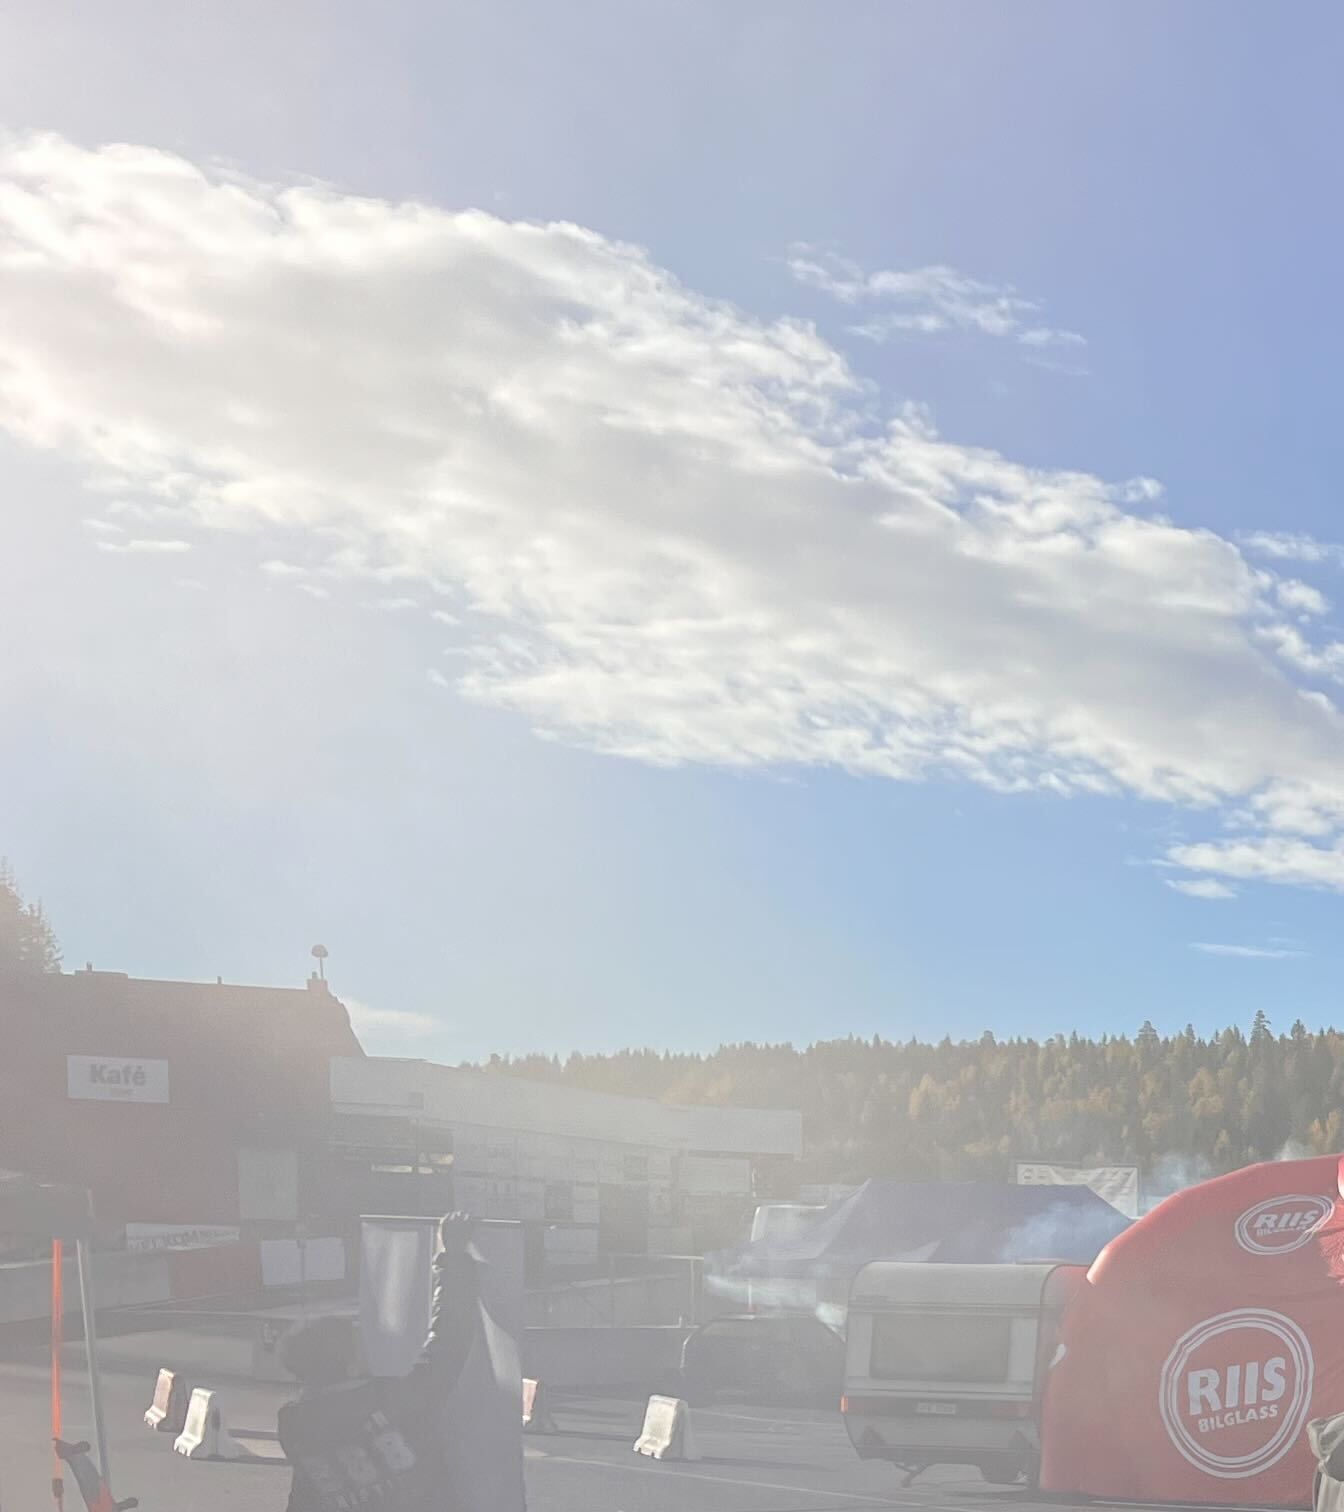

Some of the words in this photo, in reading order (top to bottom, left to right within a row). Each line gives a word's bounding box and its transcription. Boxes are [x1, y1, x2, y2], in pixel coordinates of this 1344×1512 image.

[89, 1064, 147, 1086] Kafé
[1253, 1210, 1319, 1228] RIIS
[1187, 1356, 1287, 1416] RIIS
[1198, 1404, 1279, 1433] BILGLASS
